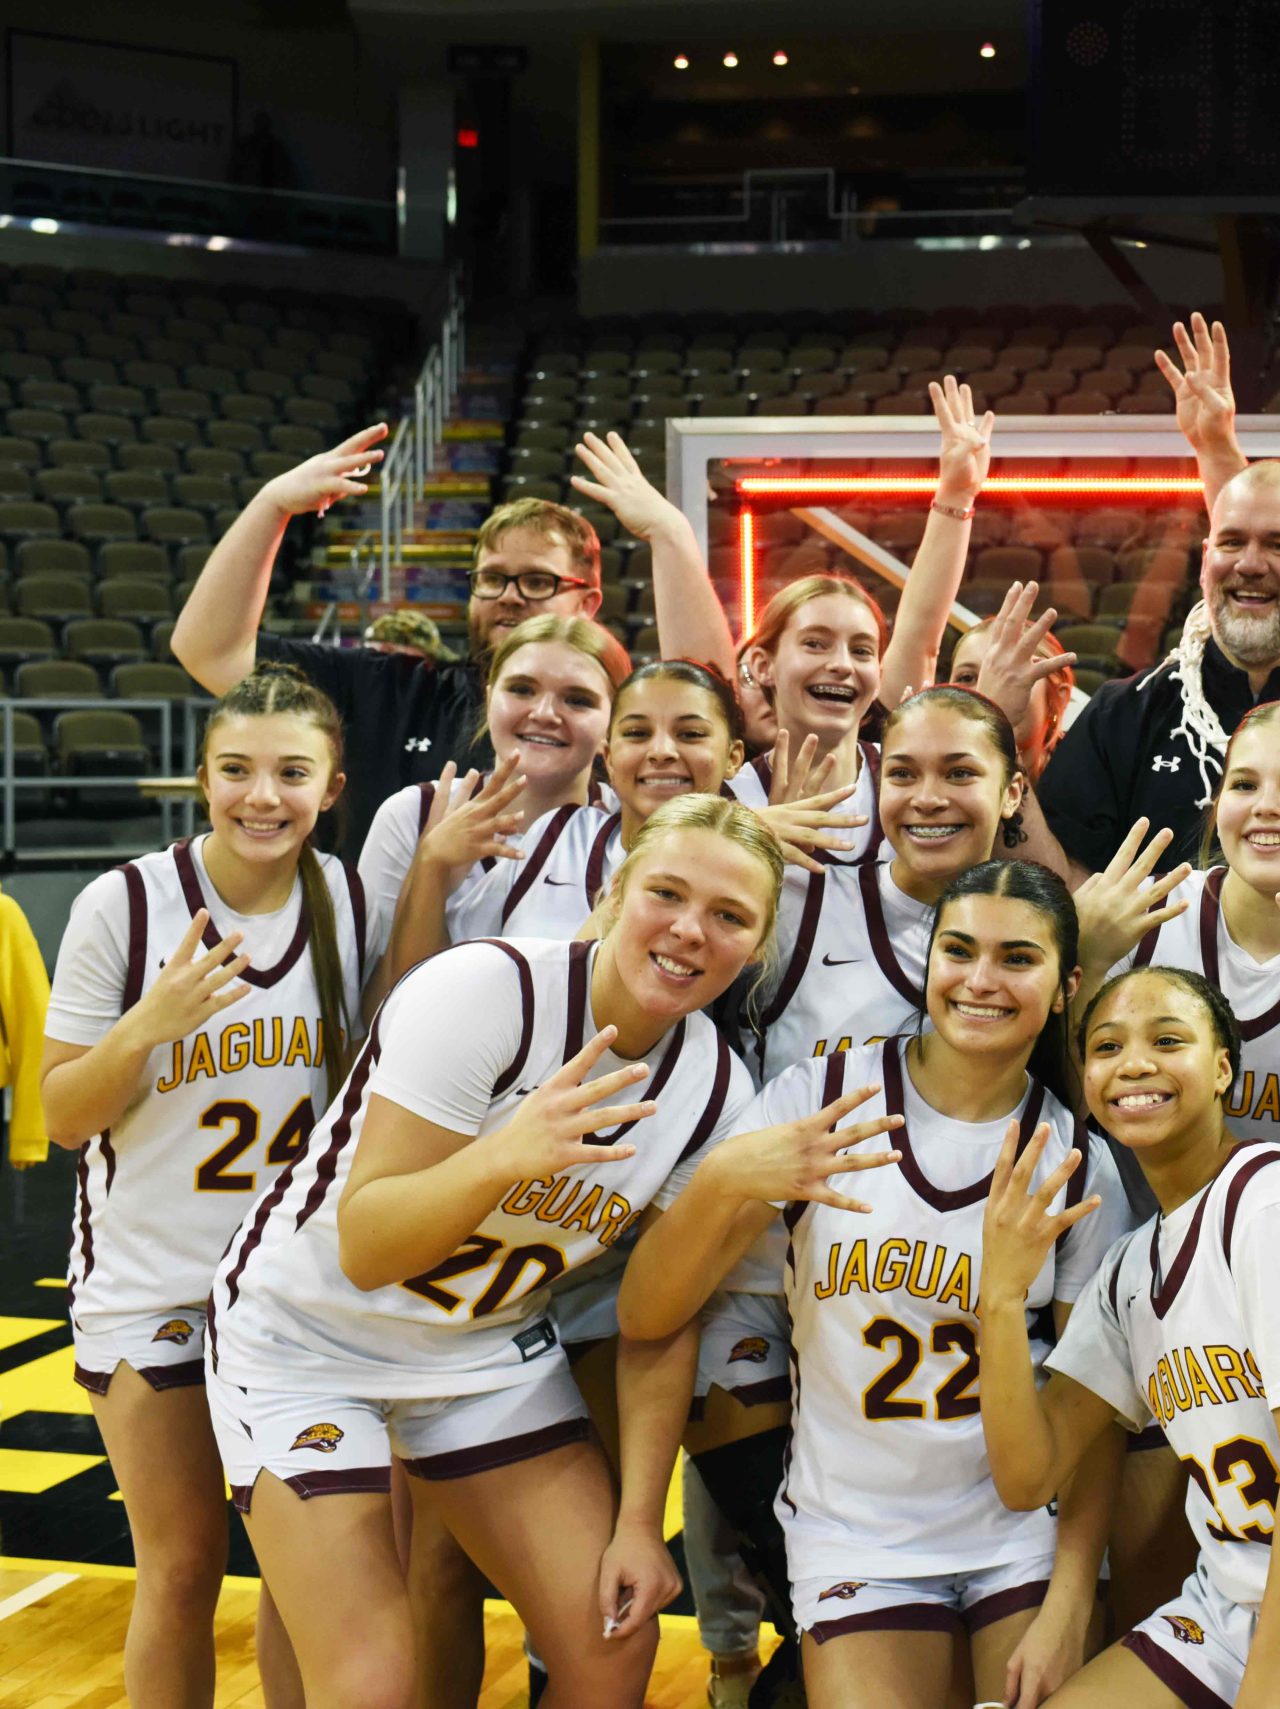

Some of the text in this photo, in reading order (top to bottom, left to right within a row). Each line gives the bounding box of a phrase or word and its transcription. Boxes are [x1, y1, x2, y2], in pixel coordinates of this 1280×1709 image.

[156, 1016, 344, 1094] JAGUA
[501, 1174, 643, 1247] GUAR
[396, 1231, 569, 1320] 20
[814, 1237, 980, 1320] JAGUA
[861, 1315, 980, 1422] 22
[1142, 1344, 1267, 1430] AGUARS
